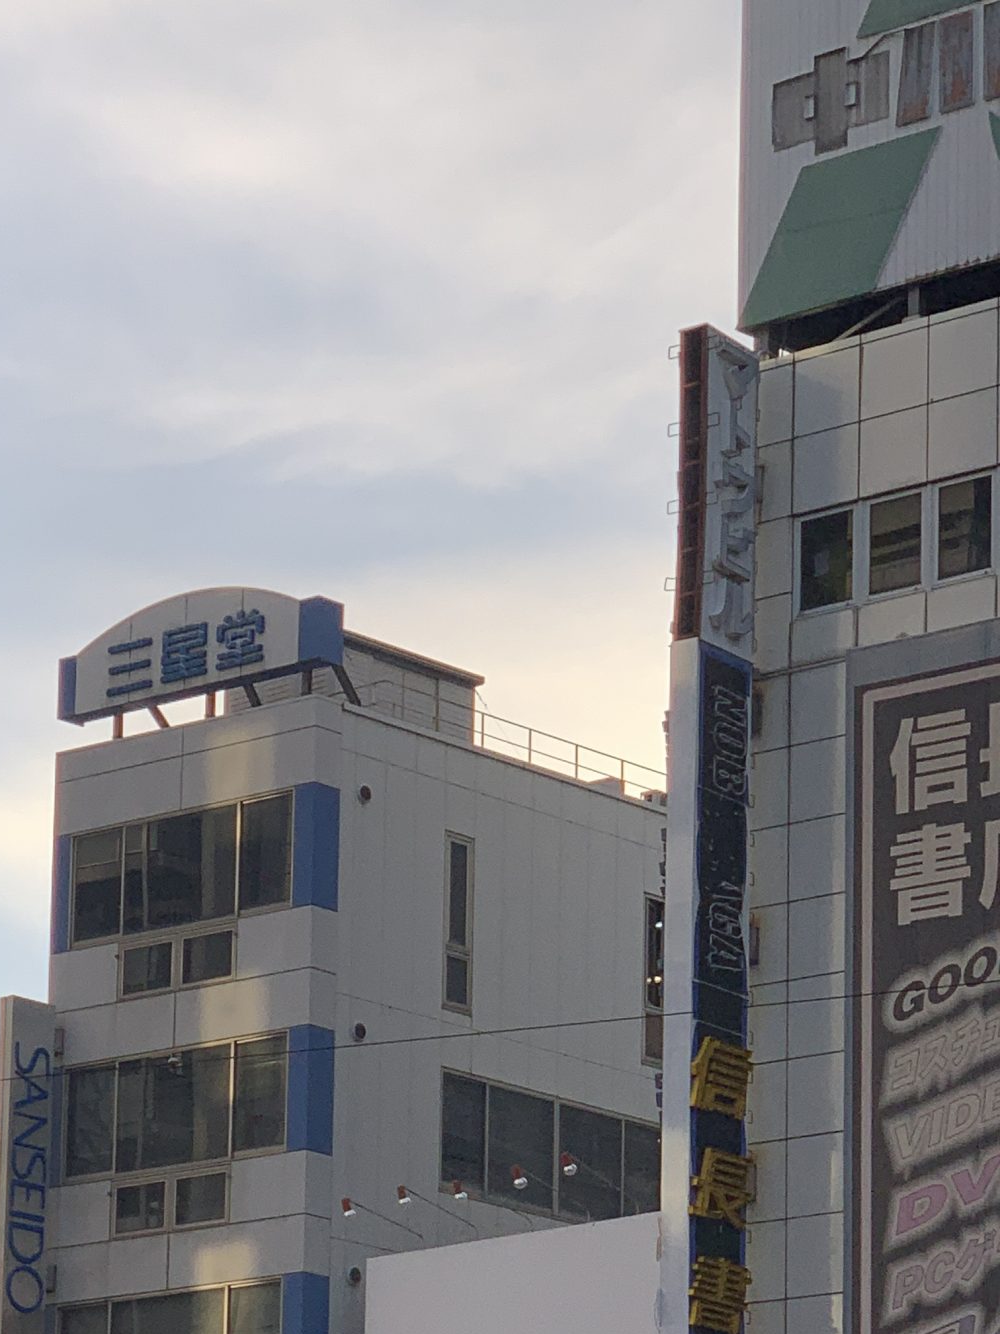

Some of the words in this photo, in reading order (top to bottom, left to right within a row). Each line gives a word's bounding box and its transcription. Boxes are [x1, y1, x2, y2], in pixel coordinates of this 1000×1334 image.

[106, 608, 266, 698] 三星堂
[889, 701, 1000, 815] 信
[889, 820, 1000, 926] 書
[4, 1040, 51, 1315] SANSEIDO
